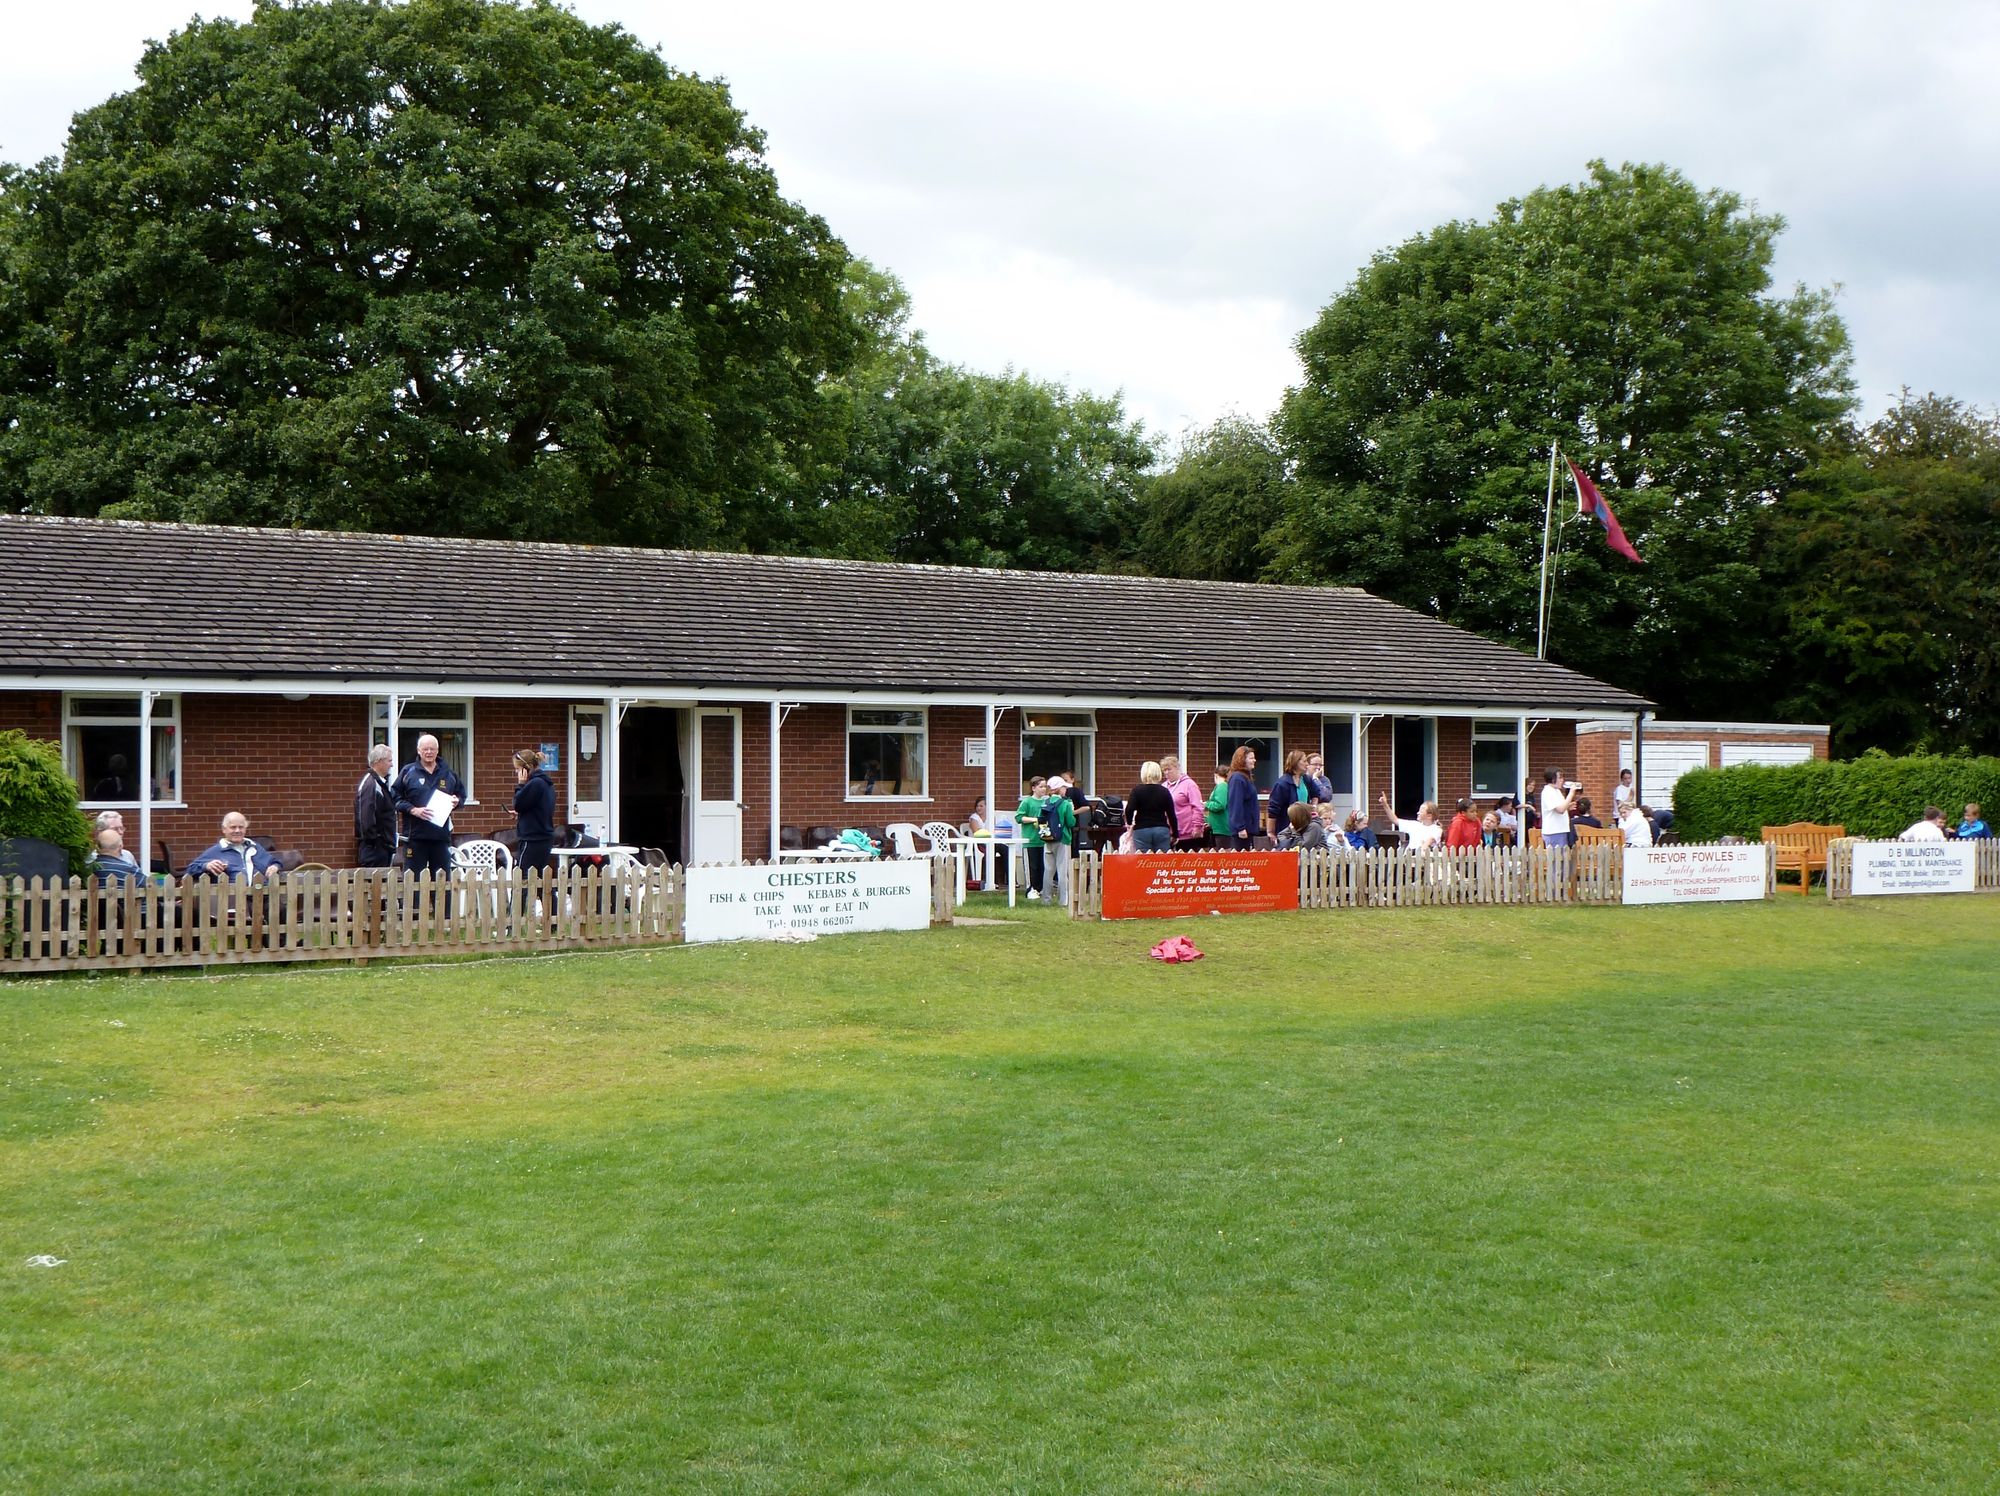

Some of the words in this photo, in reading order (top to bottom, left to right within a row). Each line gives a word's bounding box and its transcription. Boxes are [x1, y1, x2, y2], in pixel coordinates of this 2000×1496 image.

[1648, 852, 1687, 863] TREVOR
[1692, 851, 1734, 862] FOWLES
[1889, 848, 1893, 857] D
[1897, 848, 1901, 857] B
[1905, 848, 1944, 856] MILLINGTON
[1136, 858, 1177, 868] Hannah
[1181, 858, 1214, 868] Indian
[1218, 858, 1269, 868] Restaurant
[768, 870, 856, 886] CHESTERS
[710, 893, 732, 903] FISH
[739, 892, 747, 902] &
[754, 891, 784, 901] CHIPS
[808, 889, 847, 899] KEBABS
[852, 888, 860, 898] &
[866, 886, 911, 896] BURGERS
[754, 906, 781, 916] TAKE
[793, 904, 814, 914] WAY
[835, 902, 853, 912] EAT
[858, 901, 869, 911] IN
[790, 918, 819, 928] 01948
[823, 916, 854, 926] 662057
